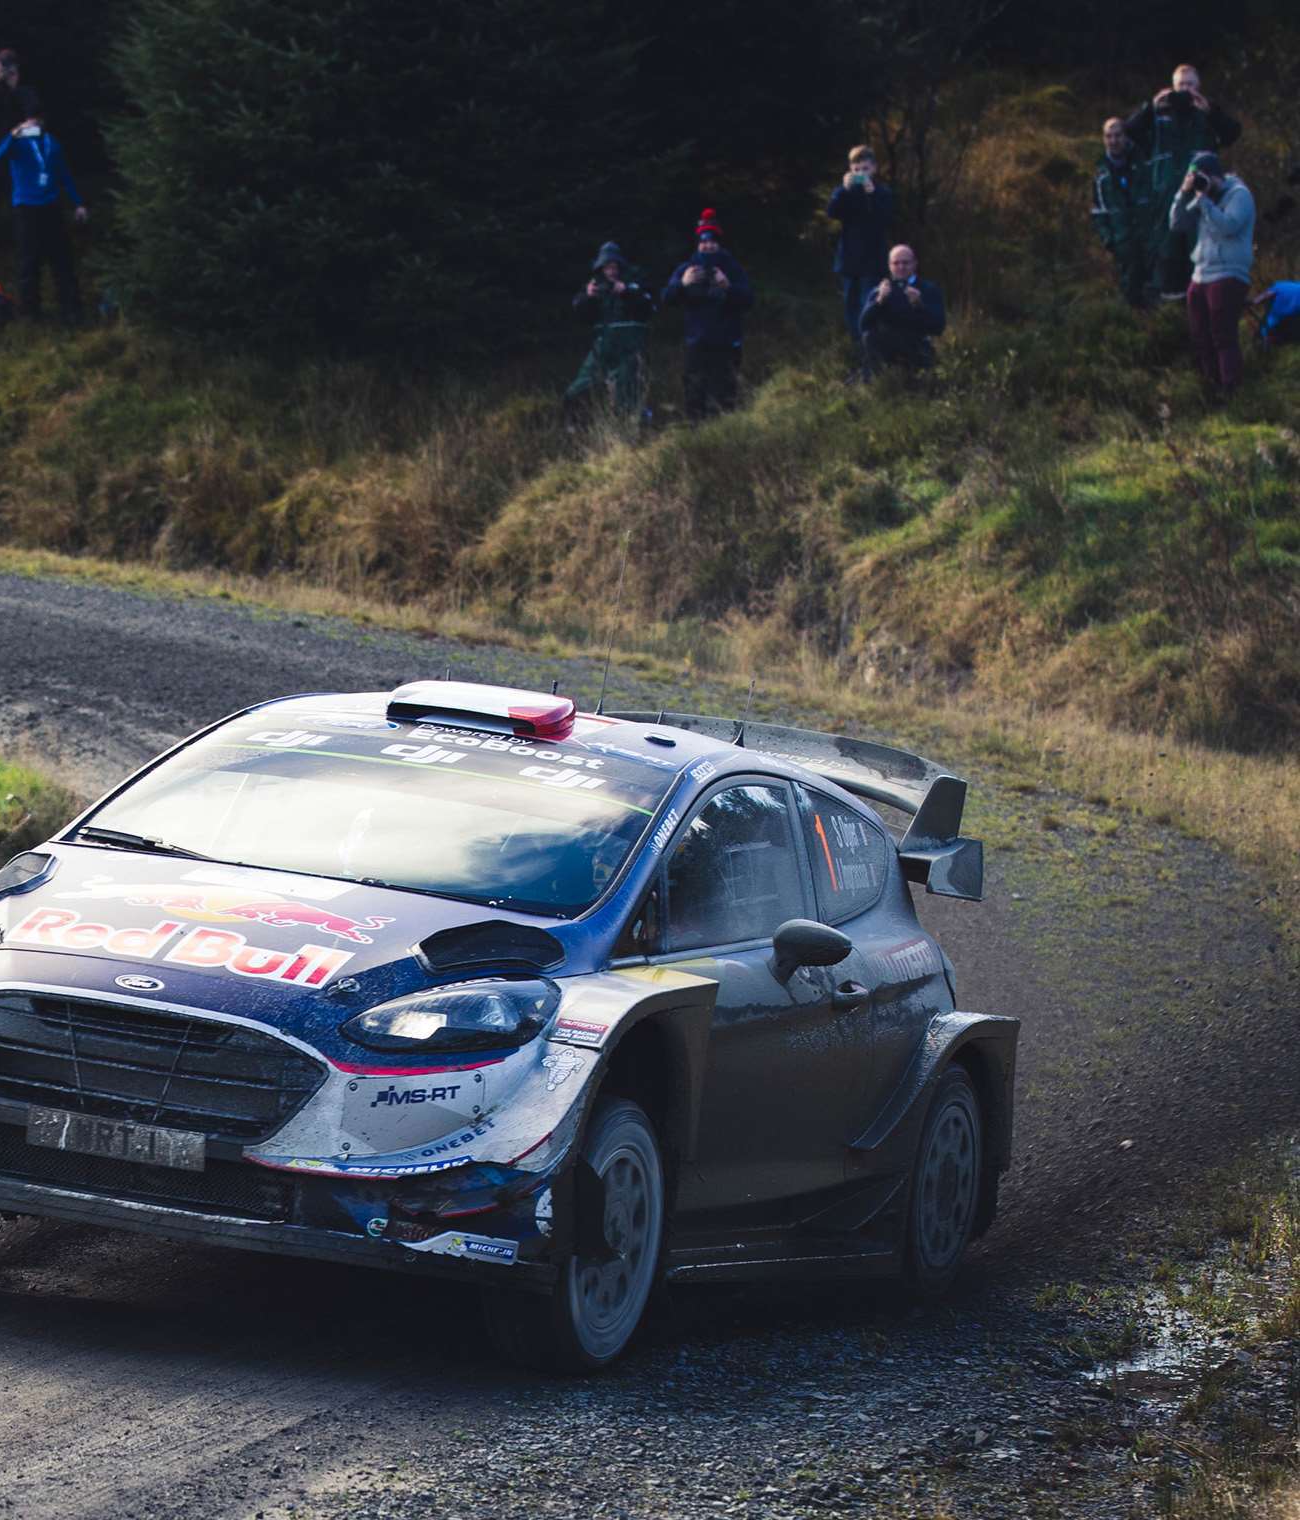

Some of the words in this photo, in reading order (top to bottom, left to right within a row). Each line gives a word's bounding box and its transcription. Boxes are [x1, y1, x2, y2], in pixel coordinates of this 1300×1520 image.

[407, 728, 605, 770] EcoBoost
[511, 734, 534, 746] by
[8, 908, 186, 957] Red
[165, 927, 353, 988] Bull
[386, 1085, 461, 1104] MS-RT
[421, 1117, 496, 1157] ONEBET
